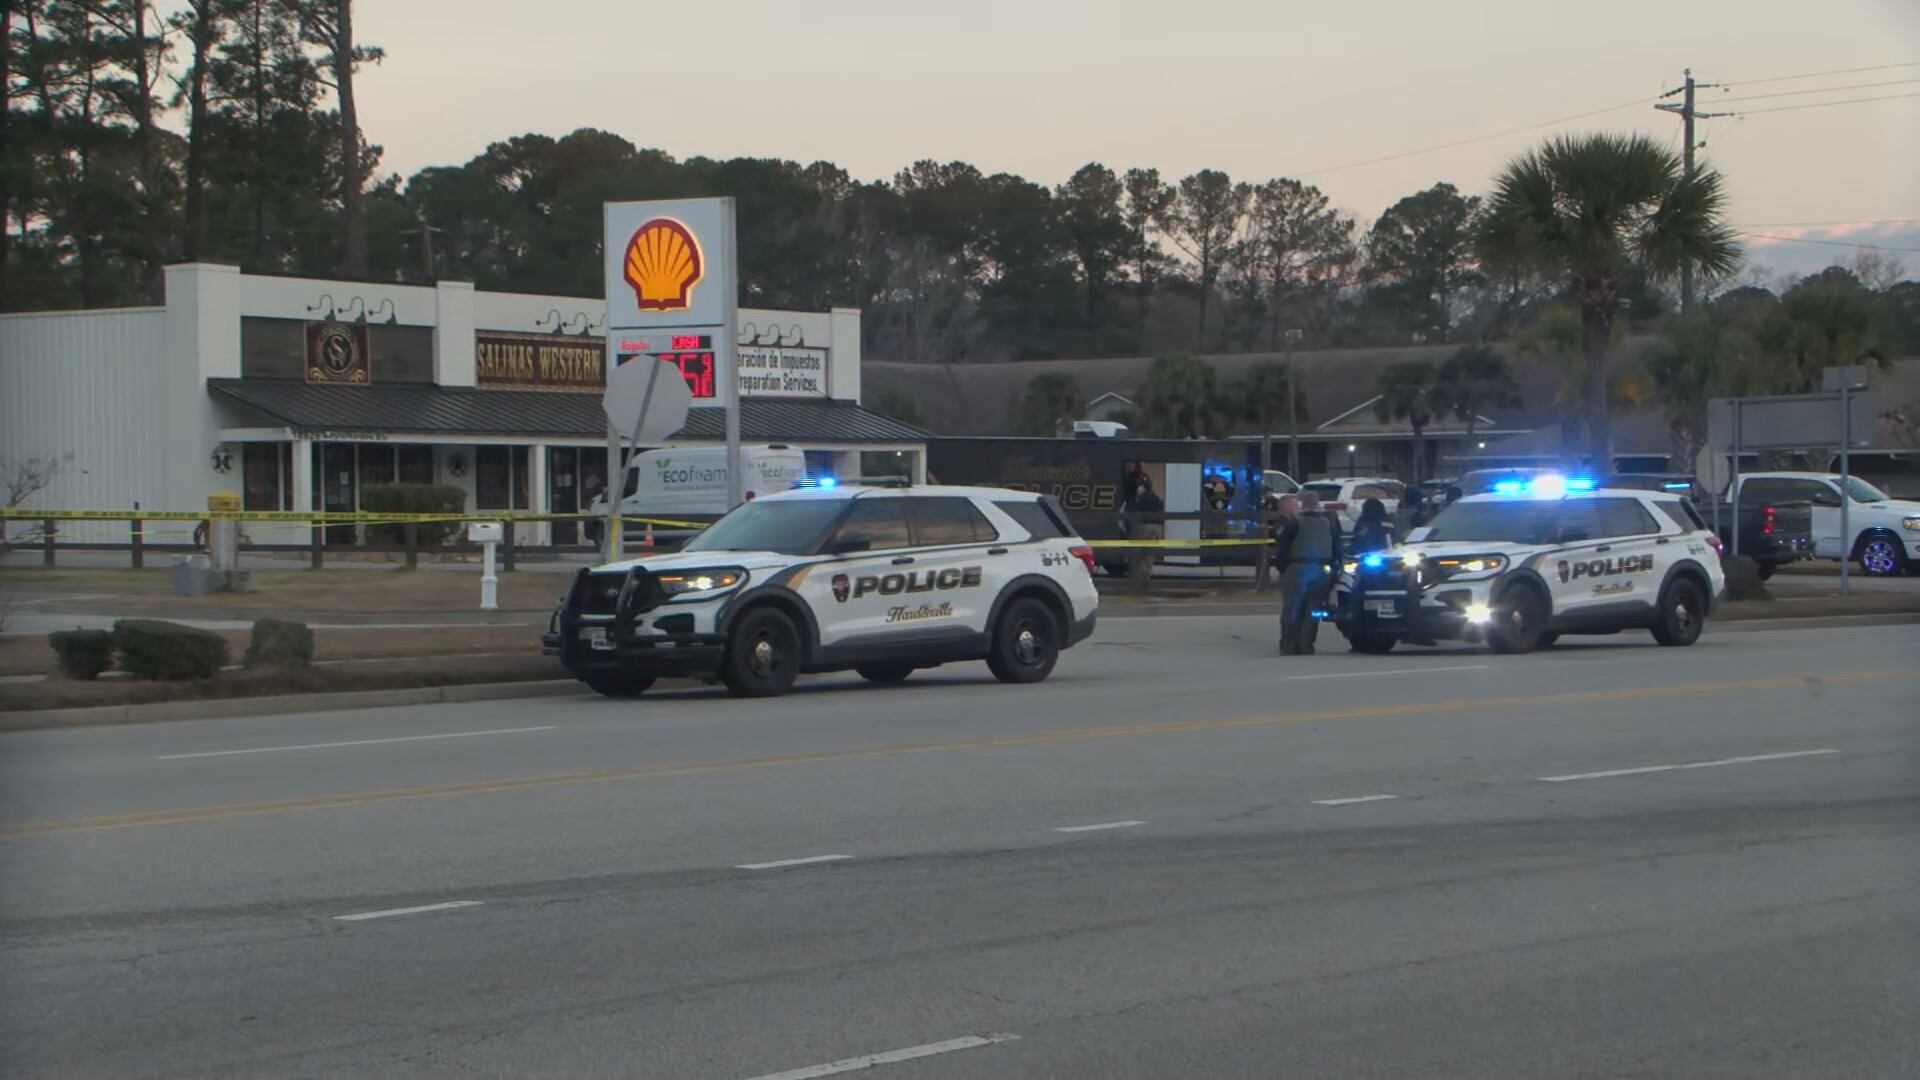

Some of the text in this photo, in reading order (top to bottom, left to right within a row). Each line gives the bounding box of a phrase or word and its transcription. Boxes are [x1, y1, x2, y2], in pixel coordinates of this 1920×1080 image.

[672, 335, 699, 350] CASH
[479, 344, 600, 380] SALINAS WESTERN
[739, 373, 781, 395] reparation
[1572, 554, 1654, 579] POLICE
[852, 566, 982, 598] POLICE
